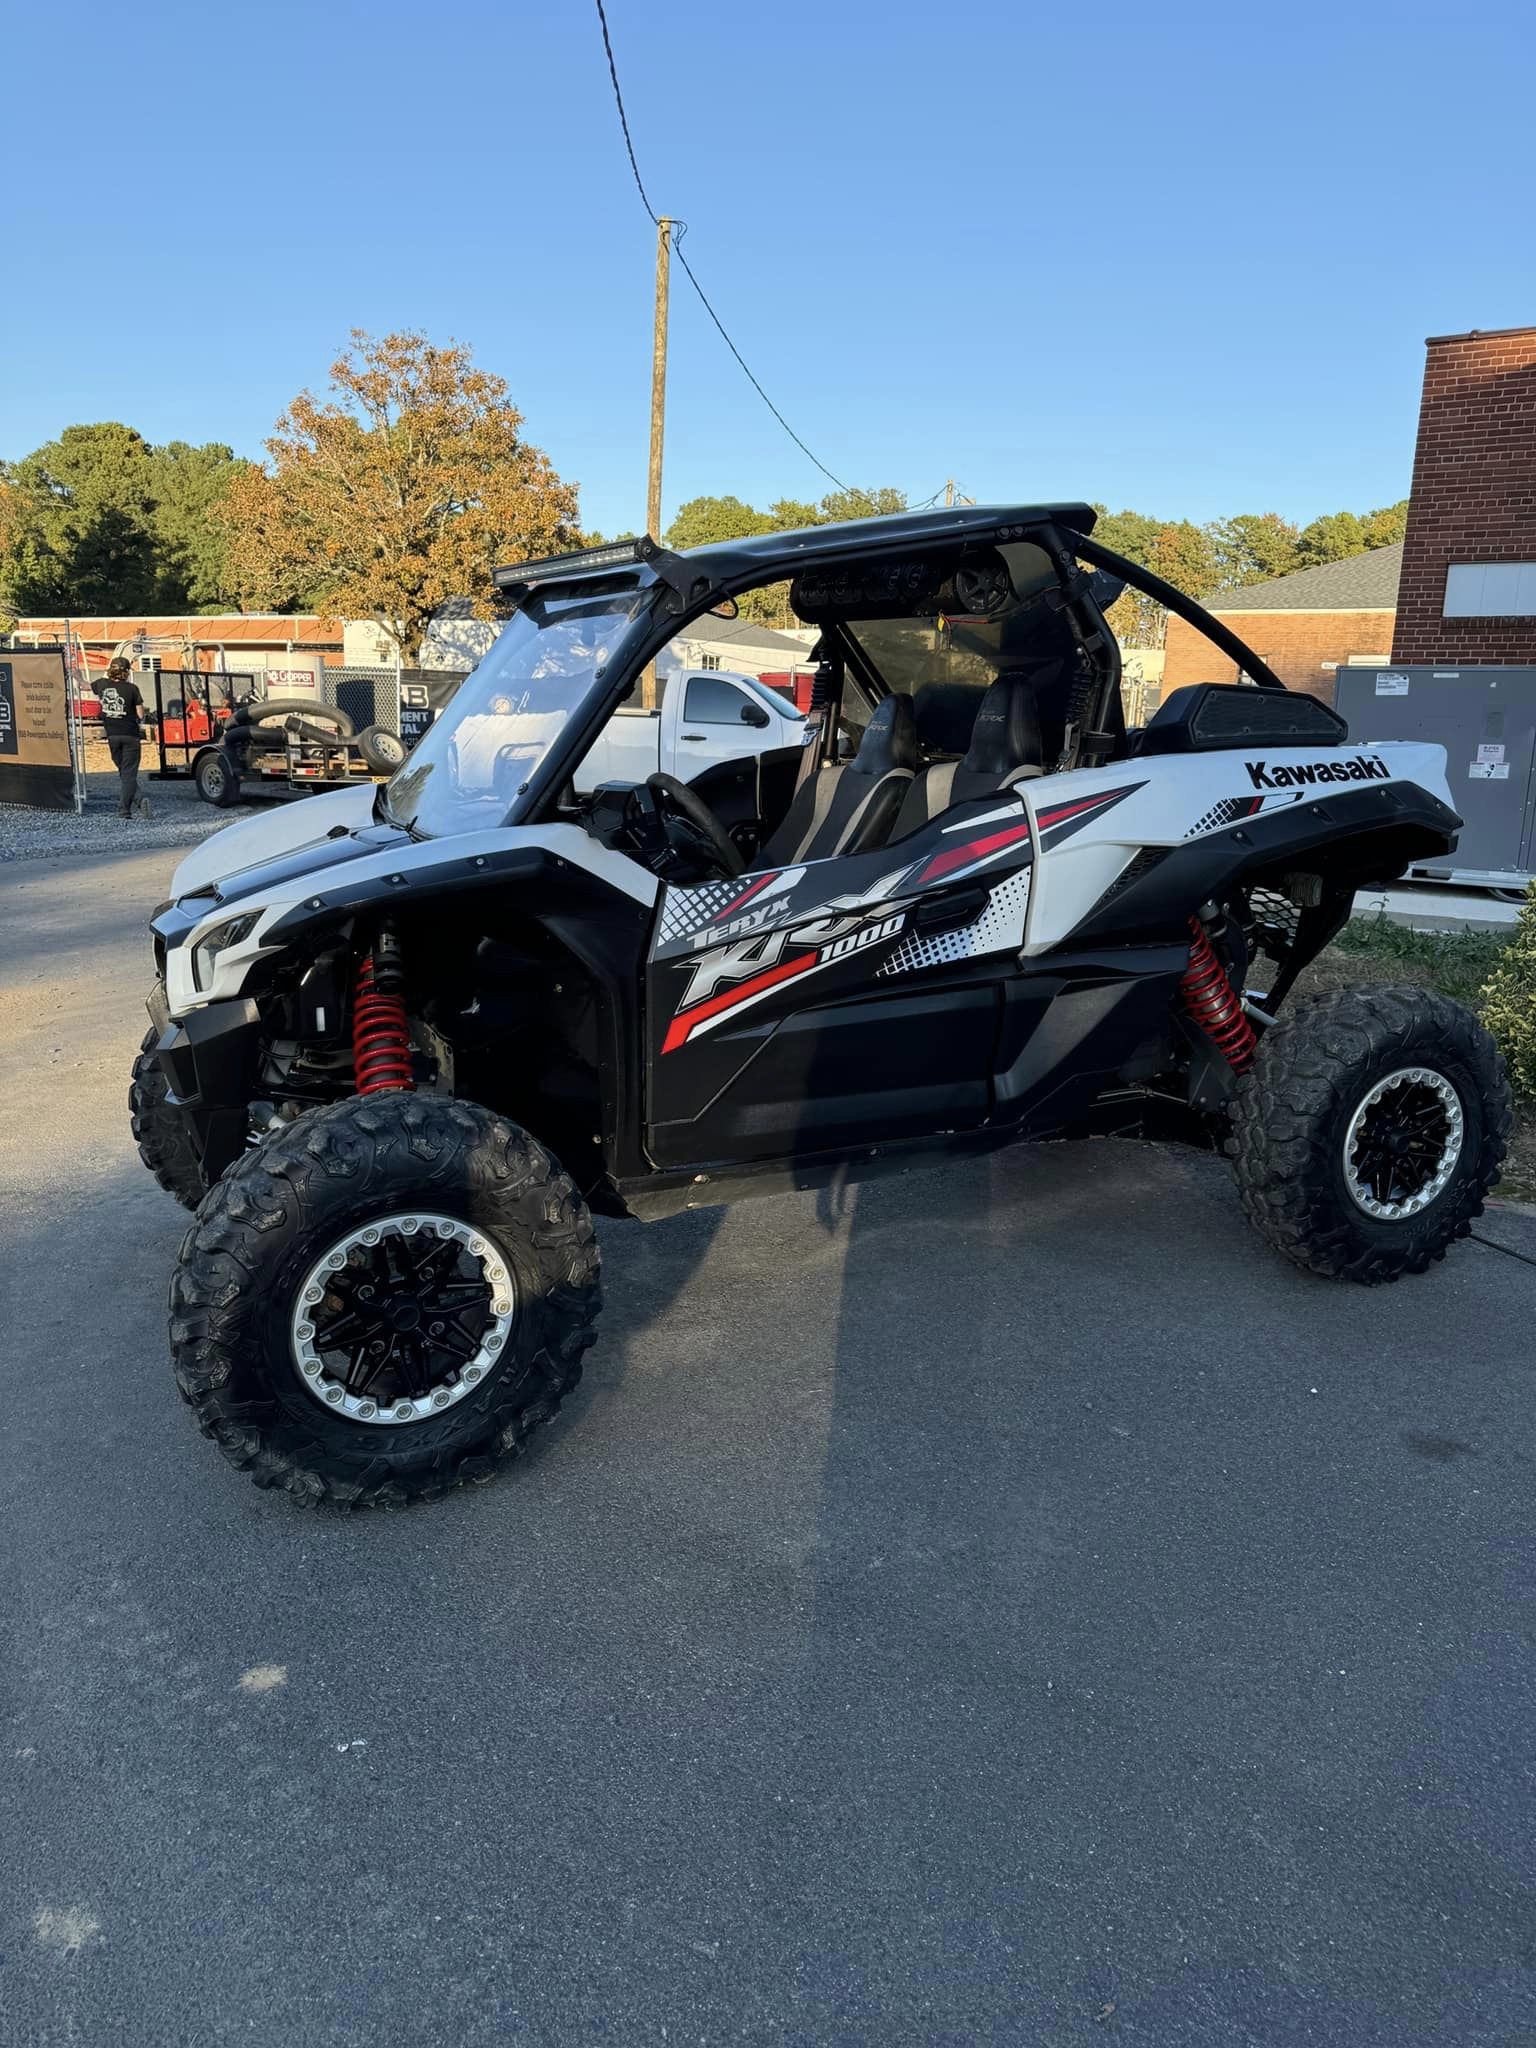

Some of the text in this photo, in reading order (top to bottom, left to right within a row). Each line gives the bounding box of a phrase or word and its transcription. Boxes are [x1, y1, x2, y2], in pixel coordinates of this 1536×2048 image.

[1244, 755, 1391, 790] Kawasaki
[687, 895, 792, 949] TERYX
[819, 913, 906, 963] 1000
